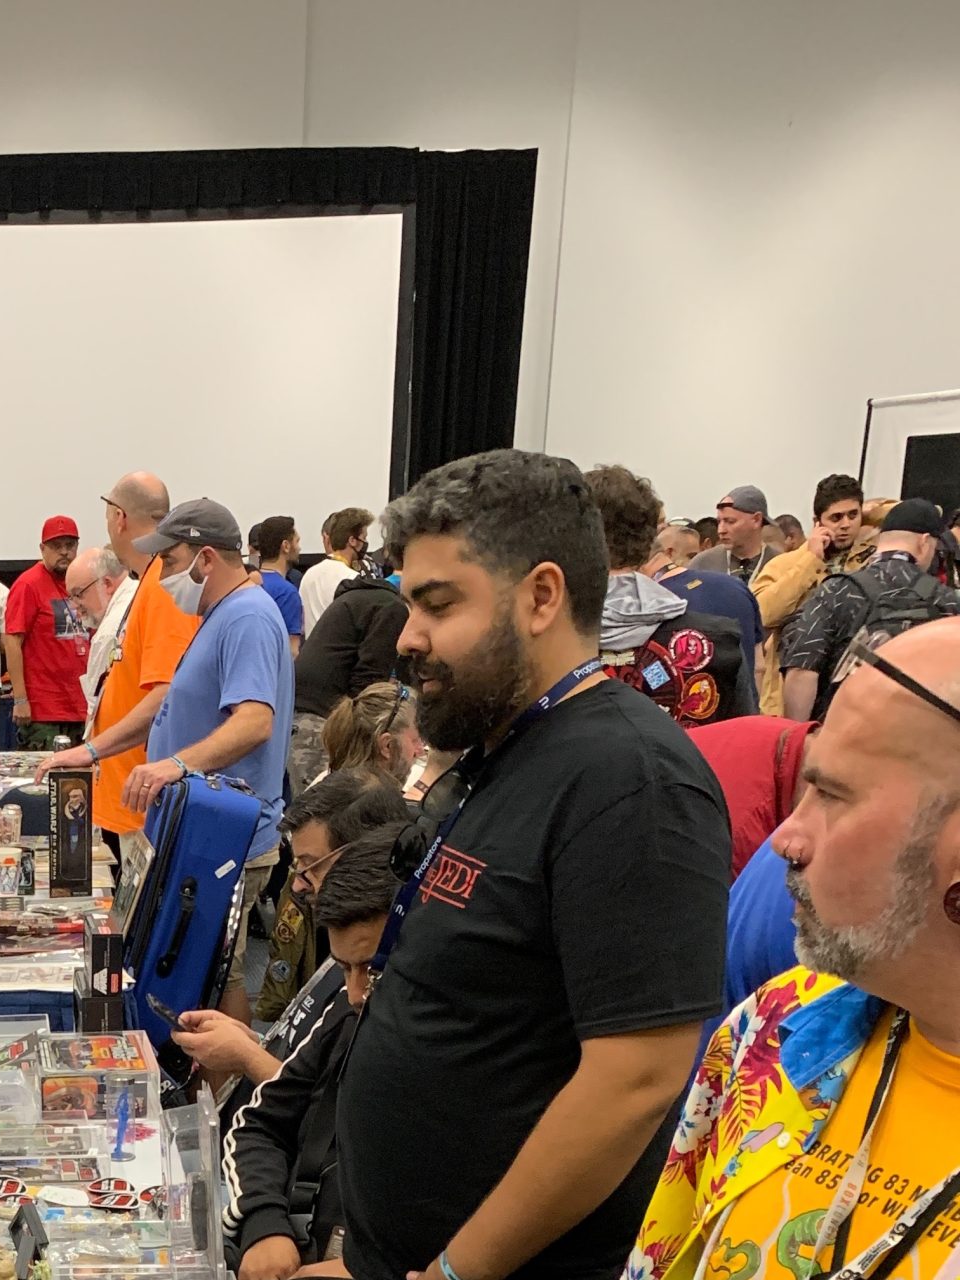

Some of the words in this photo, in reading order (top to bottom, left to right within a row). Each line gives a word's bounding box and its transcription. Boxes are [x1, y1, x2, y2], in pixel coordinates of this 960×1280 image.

[414, 836, 443, 880] Propstore
[421, 856, 482, 904] JEDI
[884, 1173, 909, 1196] 83
